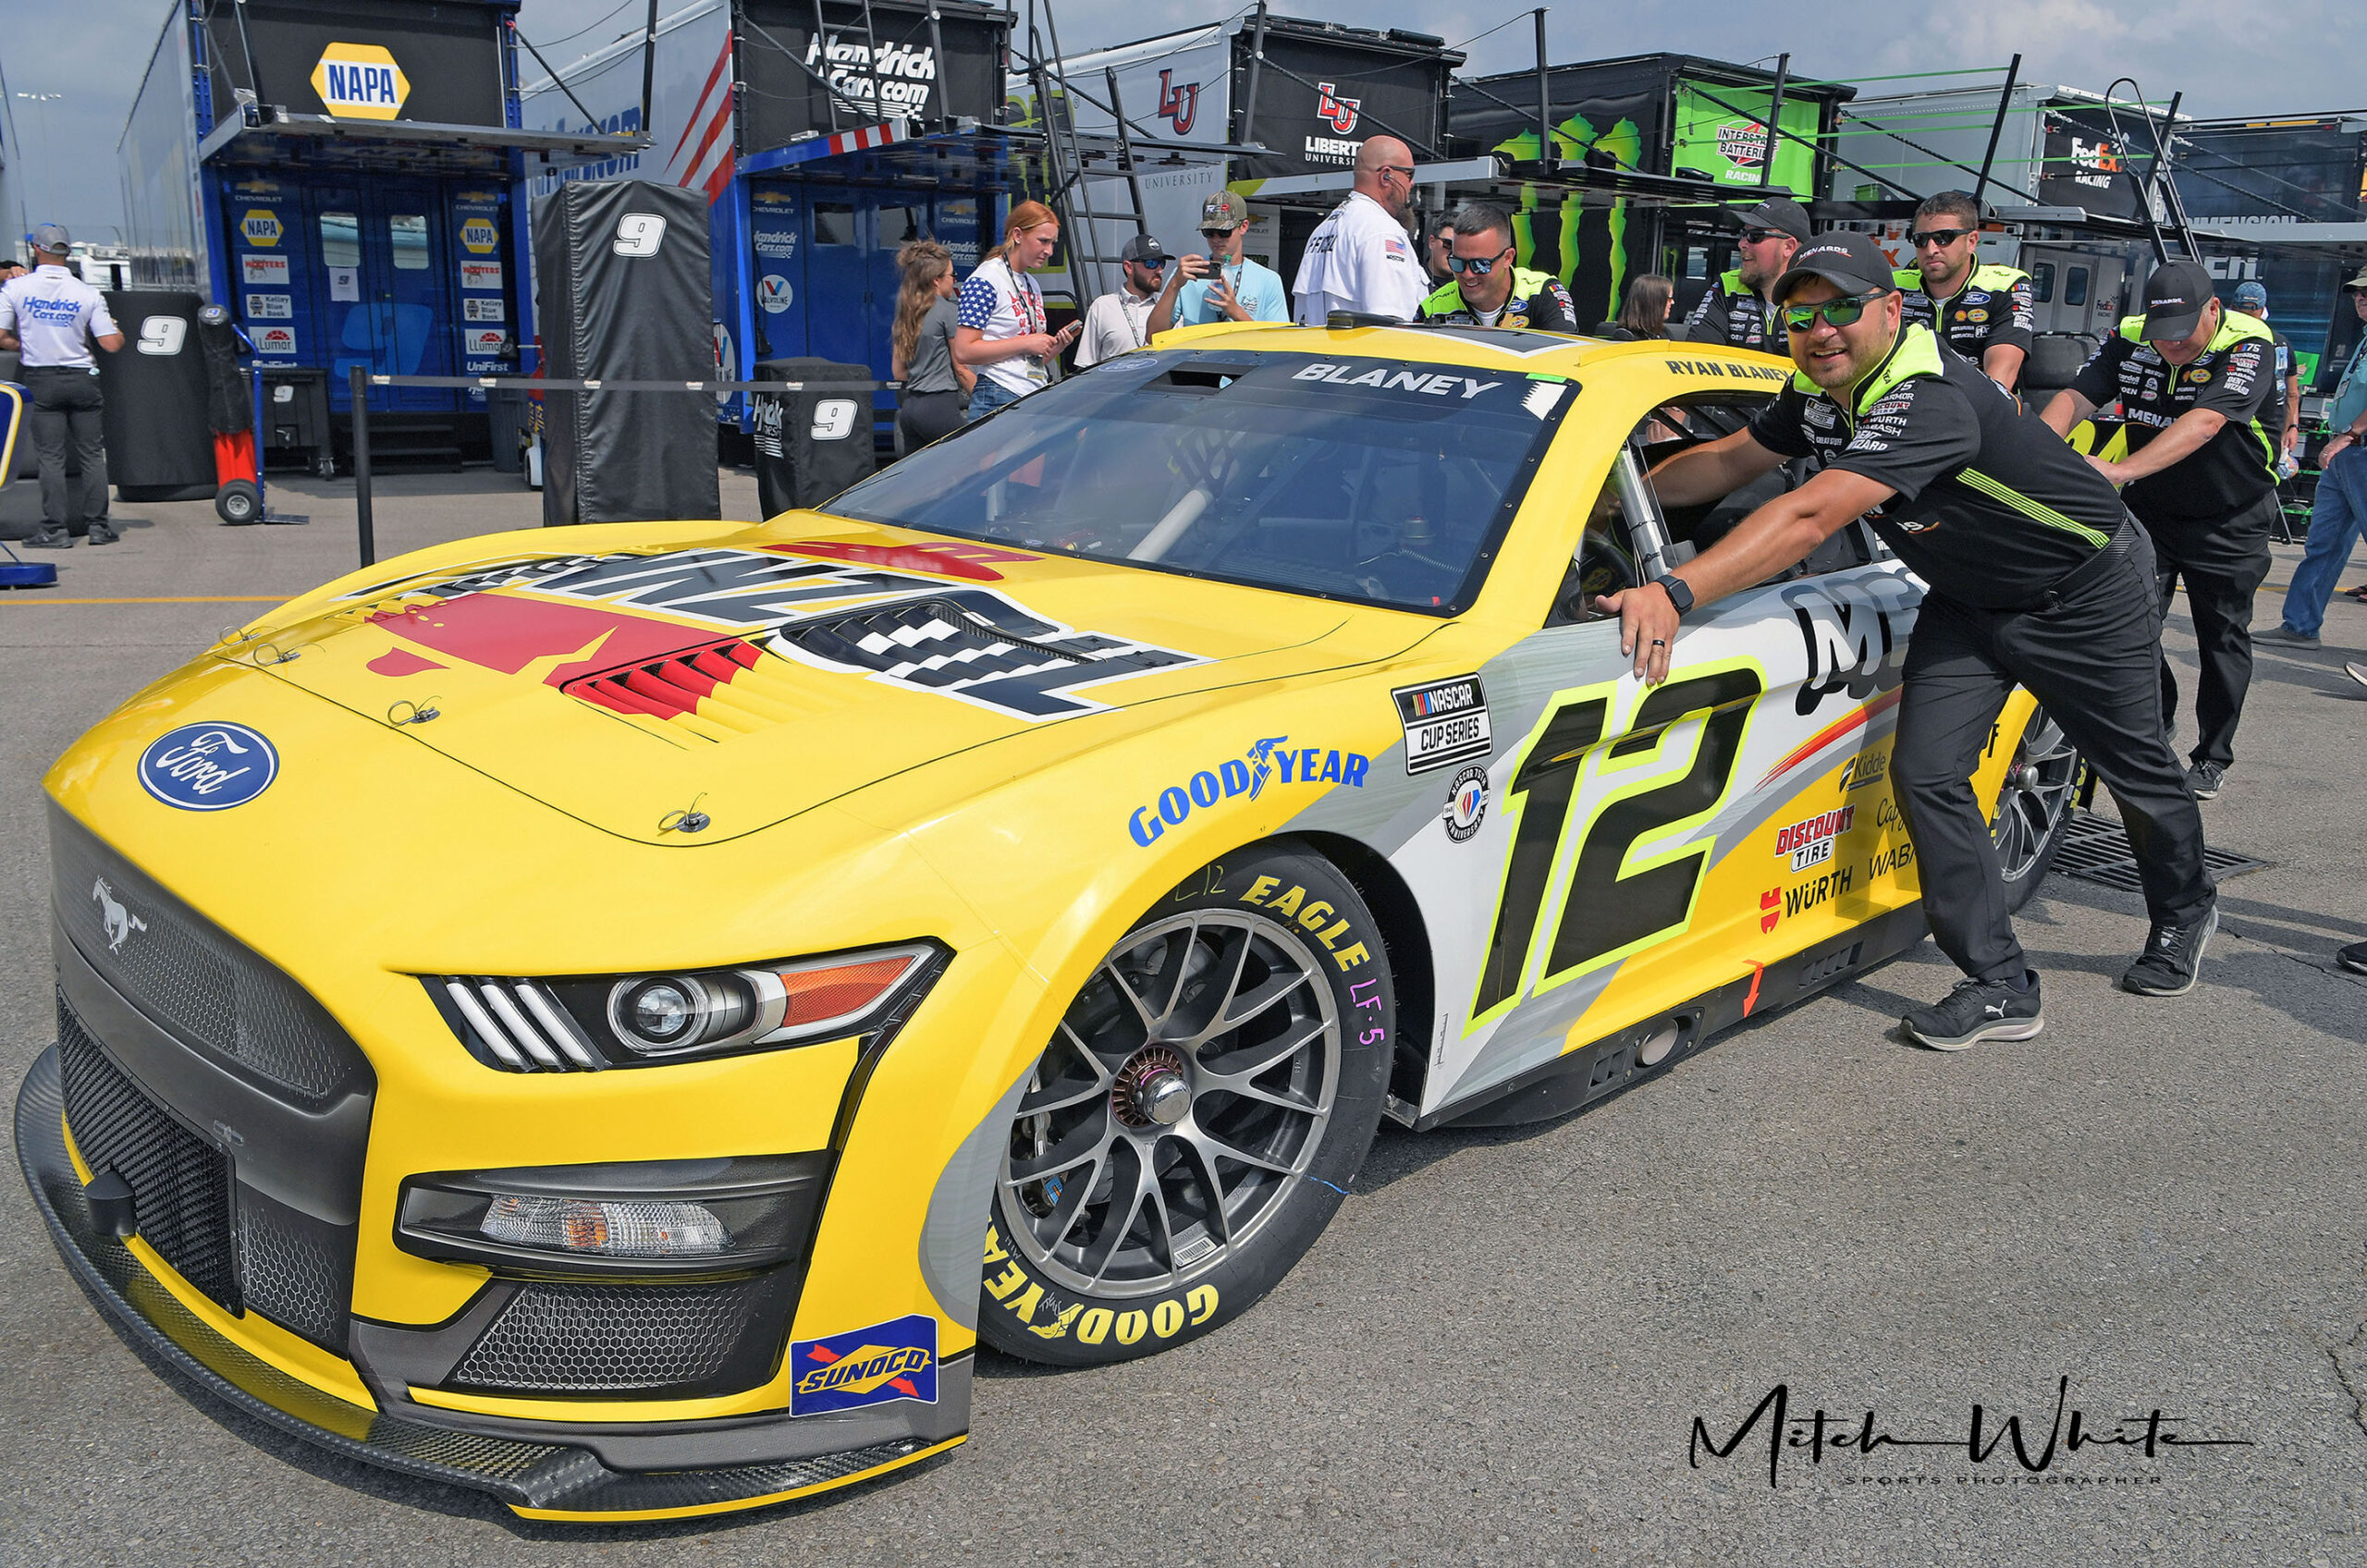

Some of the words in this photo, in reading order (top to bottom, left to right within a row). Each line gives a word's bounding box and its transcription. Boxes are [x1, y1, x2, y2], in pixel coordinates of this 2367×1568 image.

[805, 32, 936, 80] Hendrick
[328, 64, 395, 104] NAPA
[829, 69, 930, 104] Carscom
[1719, 128, 1778, 149] INTERSTAE
[1305, 153, 1355, 165] UNIVERSI
[1720, 143, 1765, 159] BATTERI
[2071, 137, 2118, 173] FedEx
[1145, 171, 1214, 189] UNIVERSITY
[1725, 169, 1761, 183] RACIN
[2075, 170, 2112, 190] RACING
[247, 219, 277, 237] NAPA
[466, 227, 493, 244] NAPA
[613, 214, 666, 258] 9
[1799, 245, 1848, 260] MENARDS
[23, 297, 82, 313] Hendrick
[265, 296, 288, 304] Kelley
[1964, 292, 1985, 302] Ford
[33, 310, 76, 323] Cars.com
[137, 316, 187, 355] 9
[469, 338, 500, 351] LLuma
[2247, 343, 2262, 352] 75
[467, 361, 509, 372] UniFirst
[1664, 361, 1725, 377] RYAN
[1292, 362, 1503, 399] BLANEY
[274, 386, 293, 402] 9
[810, 399, 858, 440] 9
[2128, 408, 2177, 428] MENA
[1429, 683, 1474, 714] NASCAR
[1421, 725, 1443, 752] CUP
[1446, 717, 1479, 745] SERIES
[156, 730, 250, 795] Ford
[1853, 751, 1886, 779] Kidde
[1452, 771, 1475, 796] NASCAR
[1775, 805, 1855, 856] DISCOUNT
[1465, 658, 1766, 1032] 12
[1797, 842, 1829, 867] TIRE
[1870, 841, 1917, 880] WAB
[1239, 875, 1372, 972] EAGLE
[801, 1348, 930, 1394] SUNOCO
